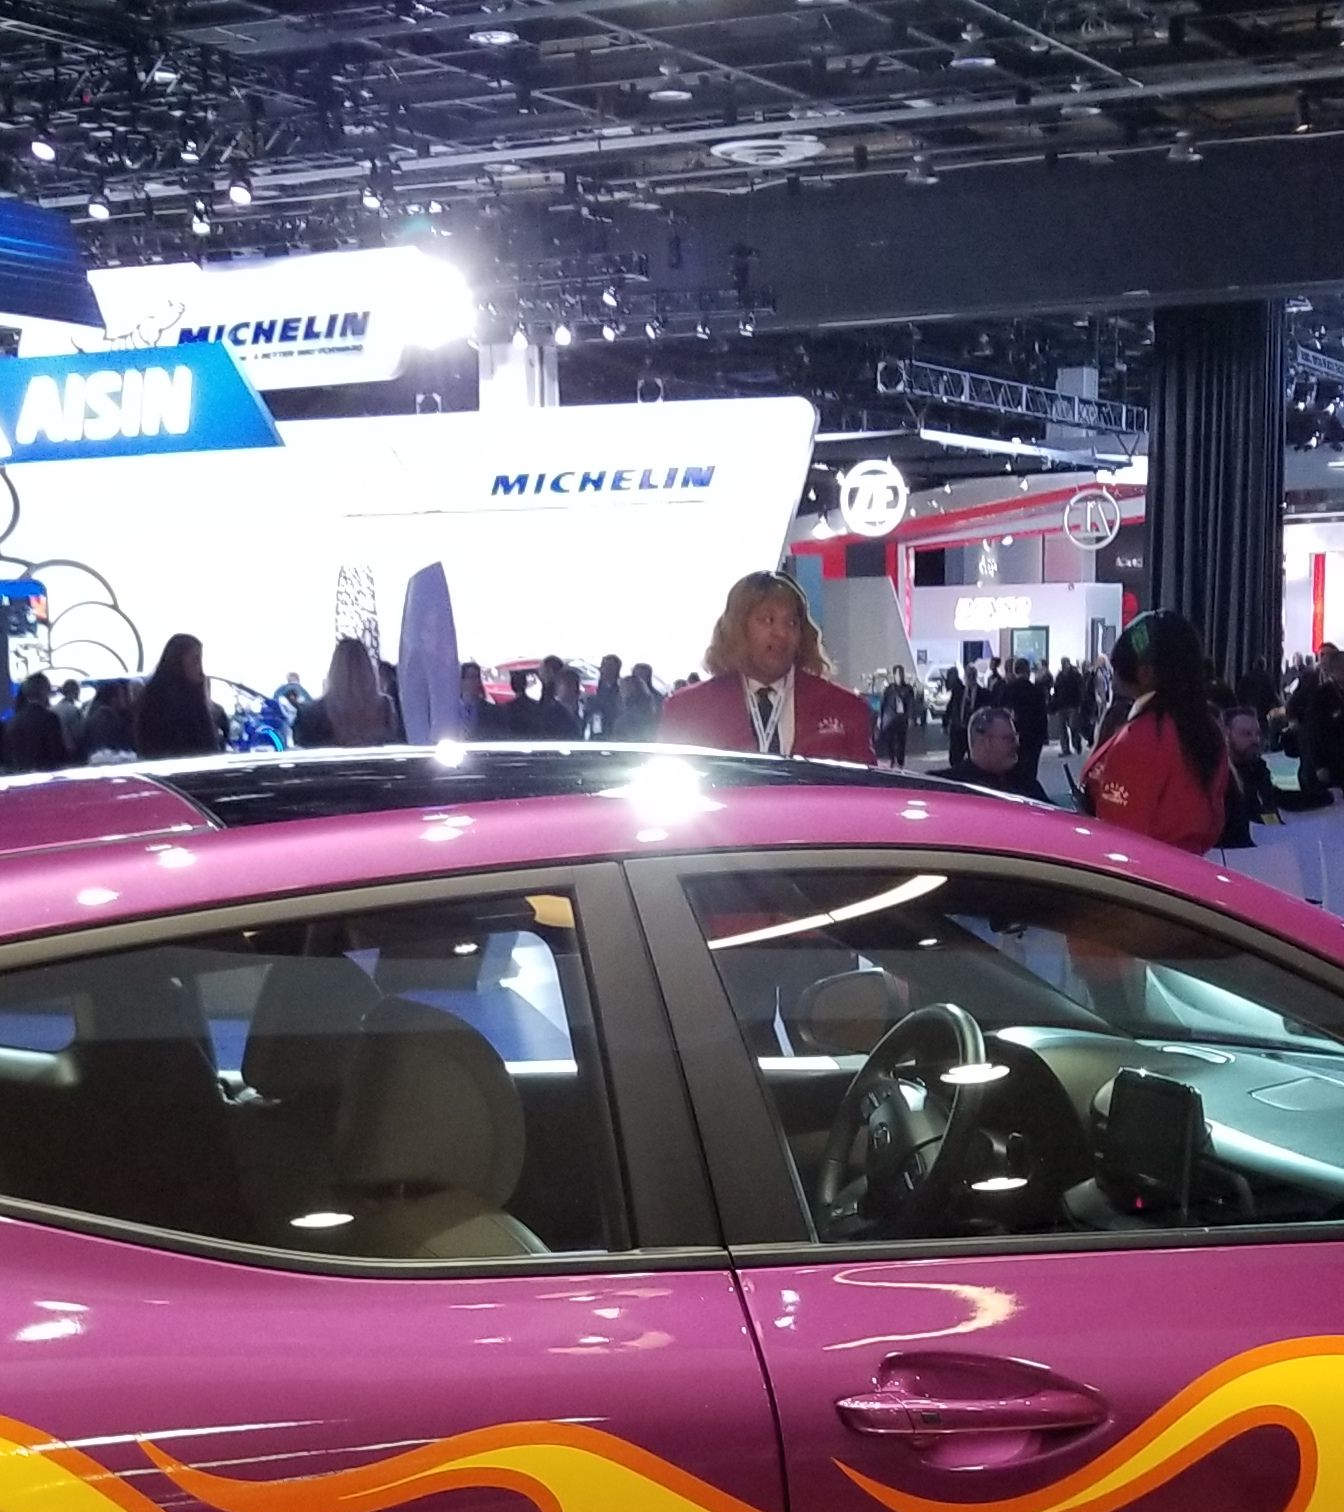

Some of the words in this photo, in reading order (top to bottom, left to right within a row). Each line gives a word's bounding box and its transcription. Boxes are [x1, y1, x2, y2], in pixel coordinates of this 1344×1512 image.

[177, 311, 370, 347] MICHELIN
[16, 365, 193, 444] AISIN
[490, 465, 715, 496] MICHELIN
